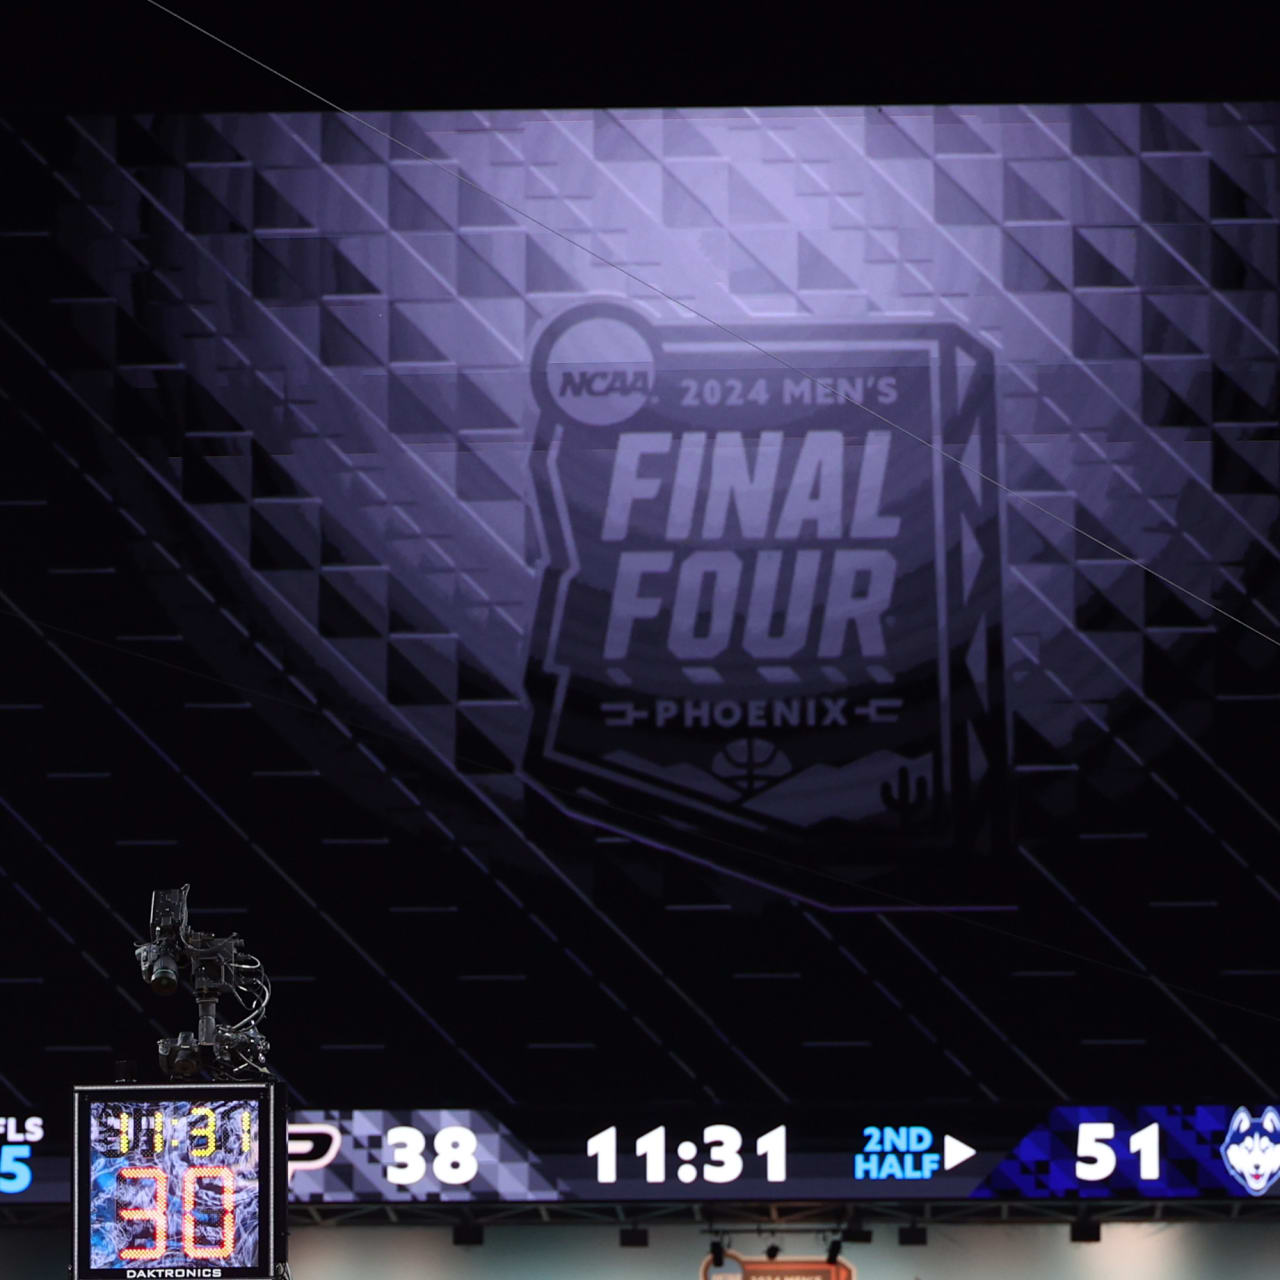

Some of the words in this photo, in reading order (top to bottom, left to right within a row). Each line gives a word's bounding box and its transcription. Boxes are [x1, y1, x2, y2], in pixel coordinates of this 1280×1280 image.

[557, 370, 654, 398] NCAA
[681, 379, 770, 406] 2024
[782, 376, 899, 405] MEN'S
[601, 431, 902, 541] FINAL
[602, 549, 898, 660] FOUR
[655, 699, 848, 728] PHOENIX
[120, 1106, 251, 1157] 11:31
[381, 1126, 478, 1185] 38
[587, 1124, 787, 1184] 11:31
[863, 1126, 934, 1153] 2ND
[1075, 1121, 1160, 1182] 51
[854, 1153, 941, 1181] HALF
[118, 1165, 236, 1260] 30
[126, 1268, 222, 1278] DAKTRONICS
